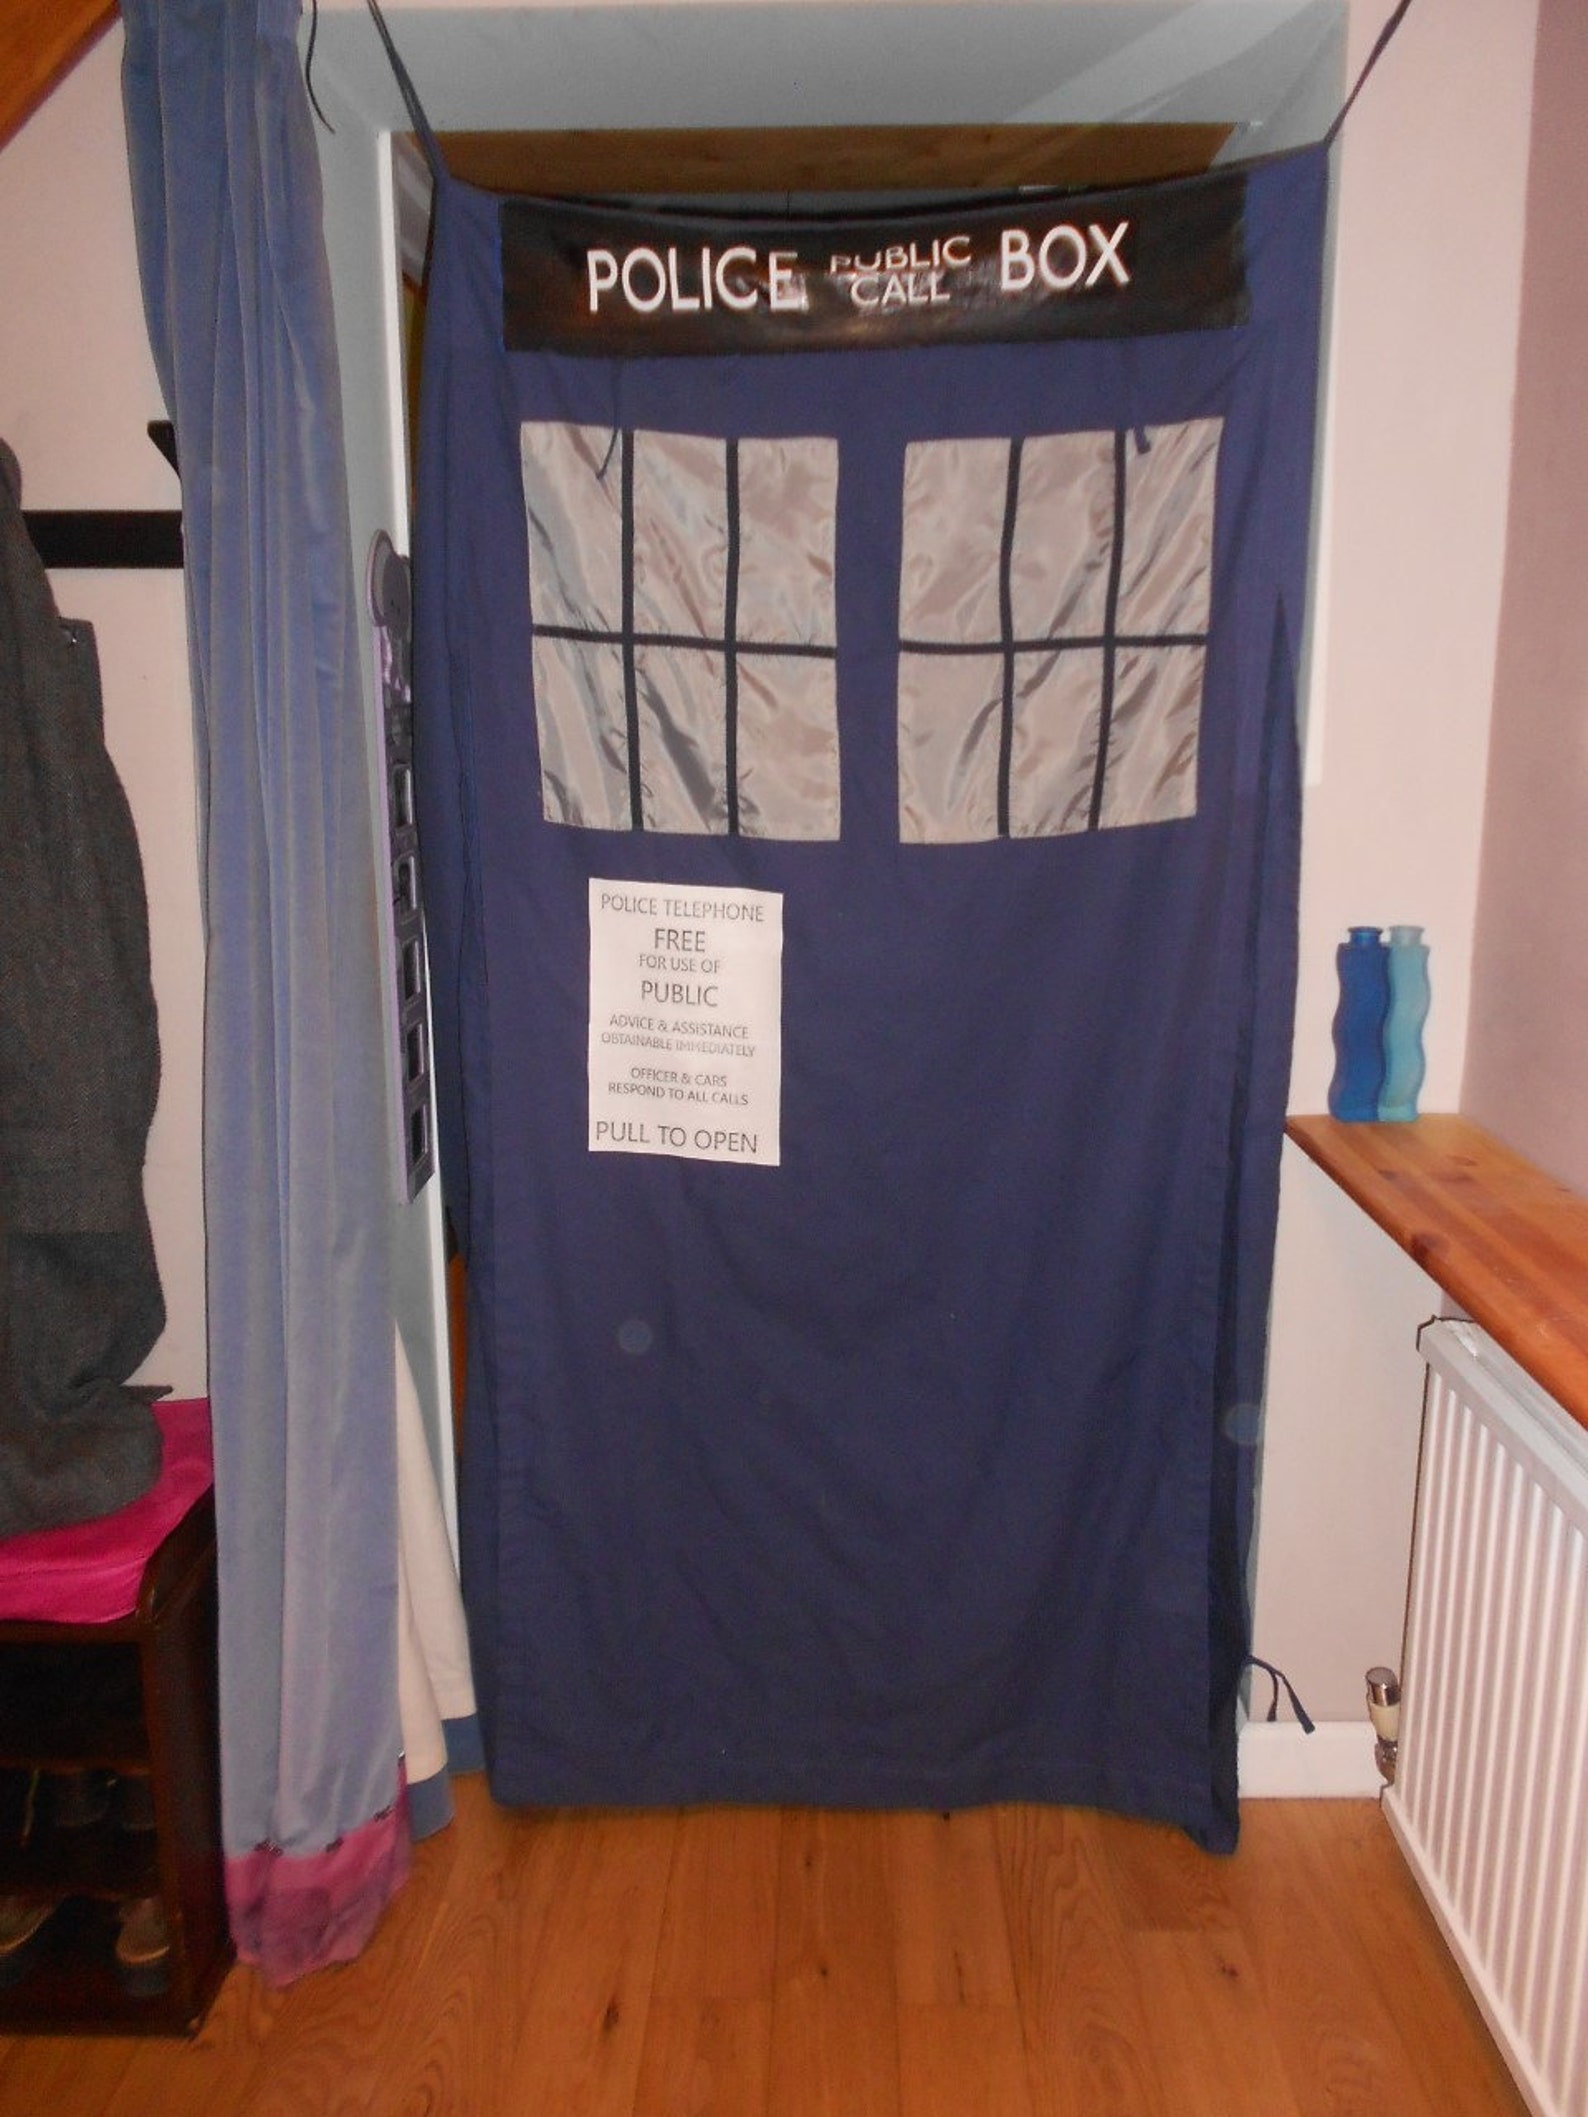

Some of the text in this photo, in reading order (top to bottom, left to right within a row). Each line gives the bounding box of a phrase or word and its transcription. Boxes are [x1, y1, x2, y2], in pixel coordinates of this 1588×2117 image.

[830, 236, 972, 273] PUBLIC
[1000, 221, 1130, 292] BOX
[586, 246, 804, 313] POLICE
[850, 273, 951, 307] CALL
[601, 893, 765, 922] POLICE TELEPHONE
[654, 928, 706, 952] FREE
[639, 954, 720, 974] FOR USE OF
[641, 980, 719, 1007] PUBLIC
[610, 1014, 749, 1039] ADVICE & ASSISTANCE
[601, 1032, 755, 1057] OBTAINABLE IMMEDIATELY
[631, 1067, 727, 1087] OFFICER & CARS
[608, 1082, 749, 1105] RESPOND TO ALL CALLS
[596, 1120, 758, 1153] PULL TO OPEN
